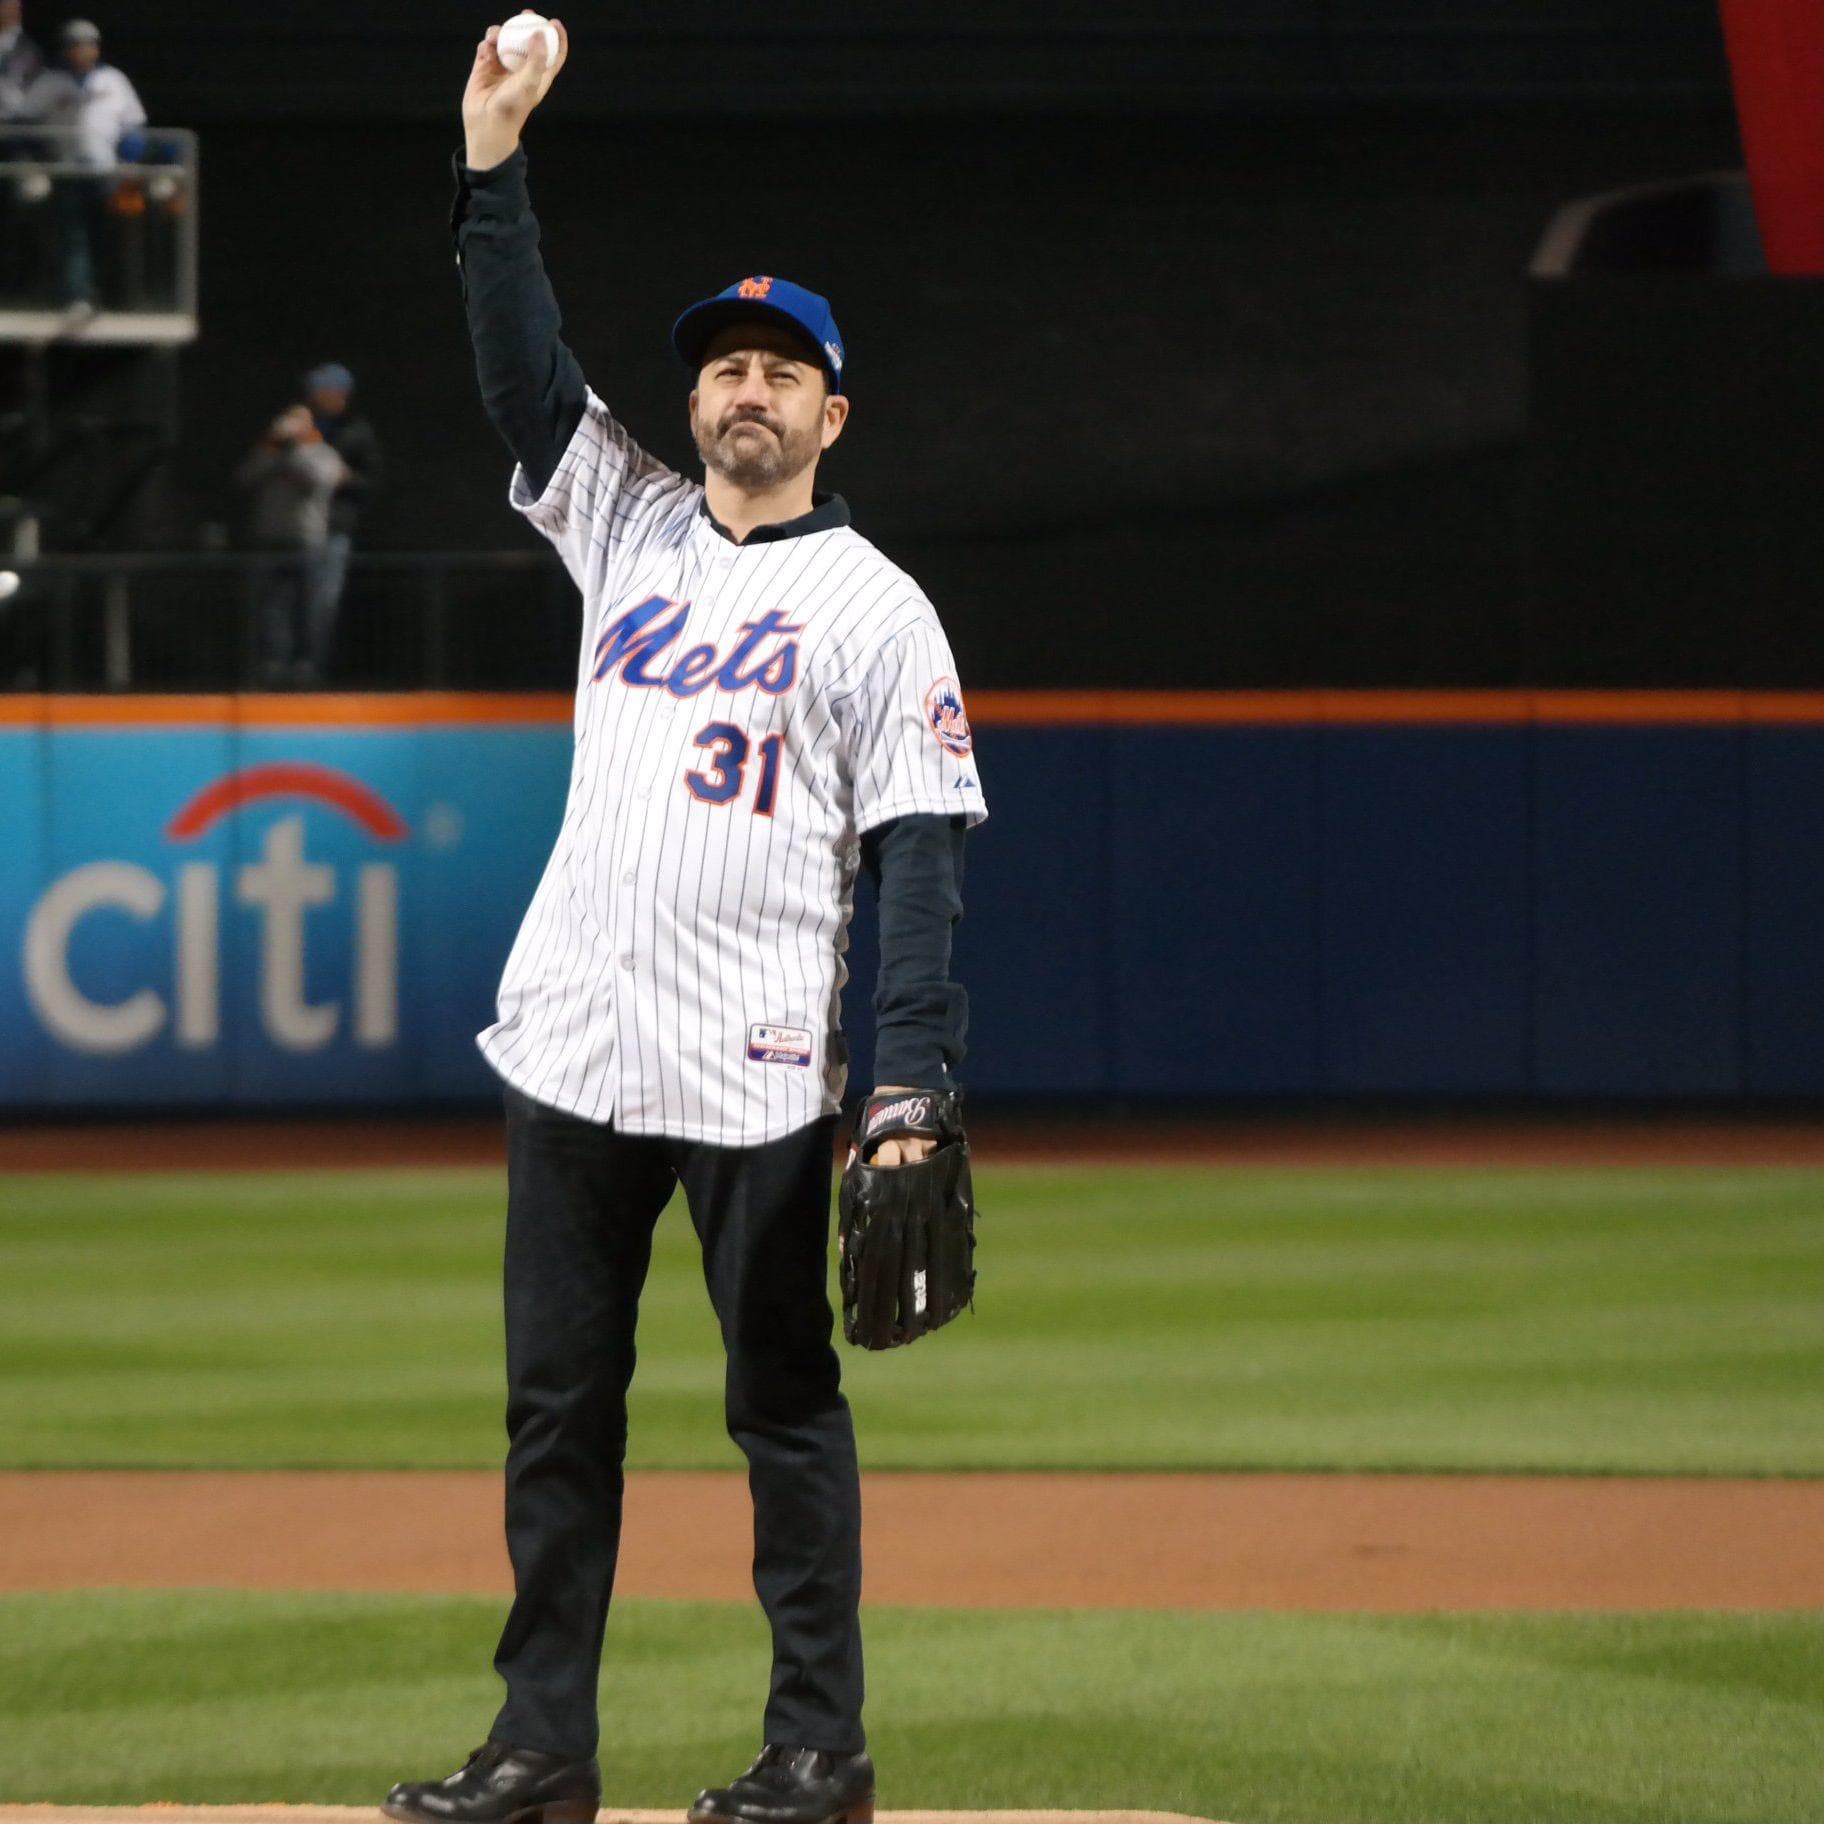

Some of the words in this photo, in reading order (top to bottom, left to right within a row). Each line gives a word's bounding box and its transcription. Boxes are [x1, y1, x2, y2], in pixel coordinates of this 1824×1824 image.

[593, 594, 807, 700] Mets
[684, 720, 787, 817] 31
[22, 815, 402, 1054] citi
